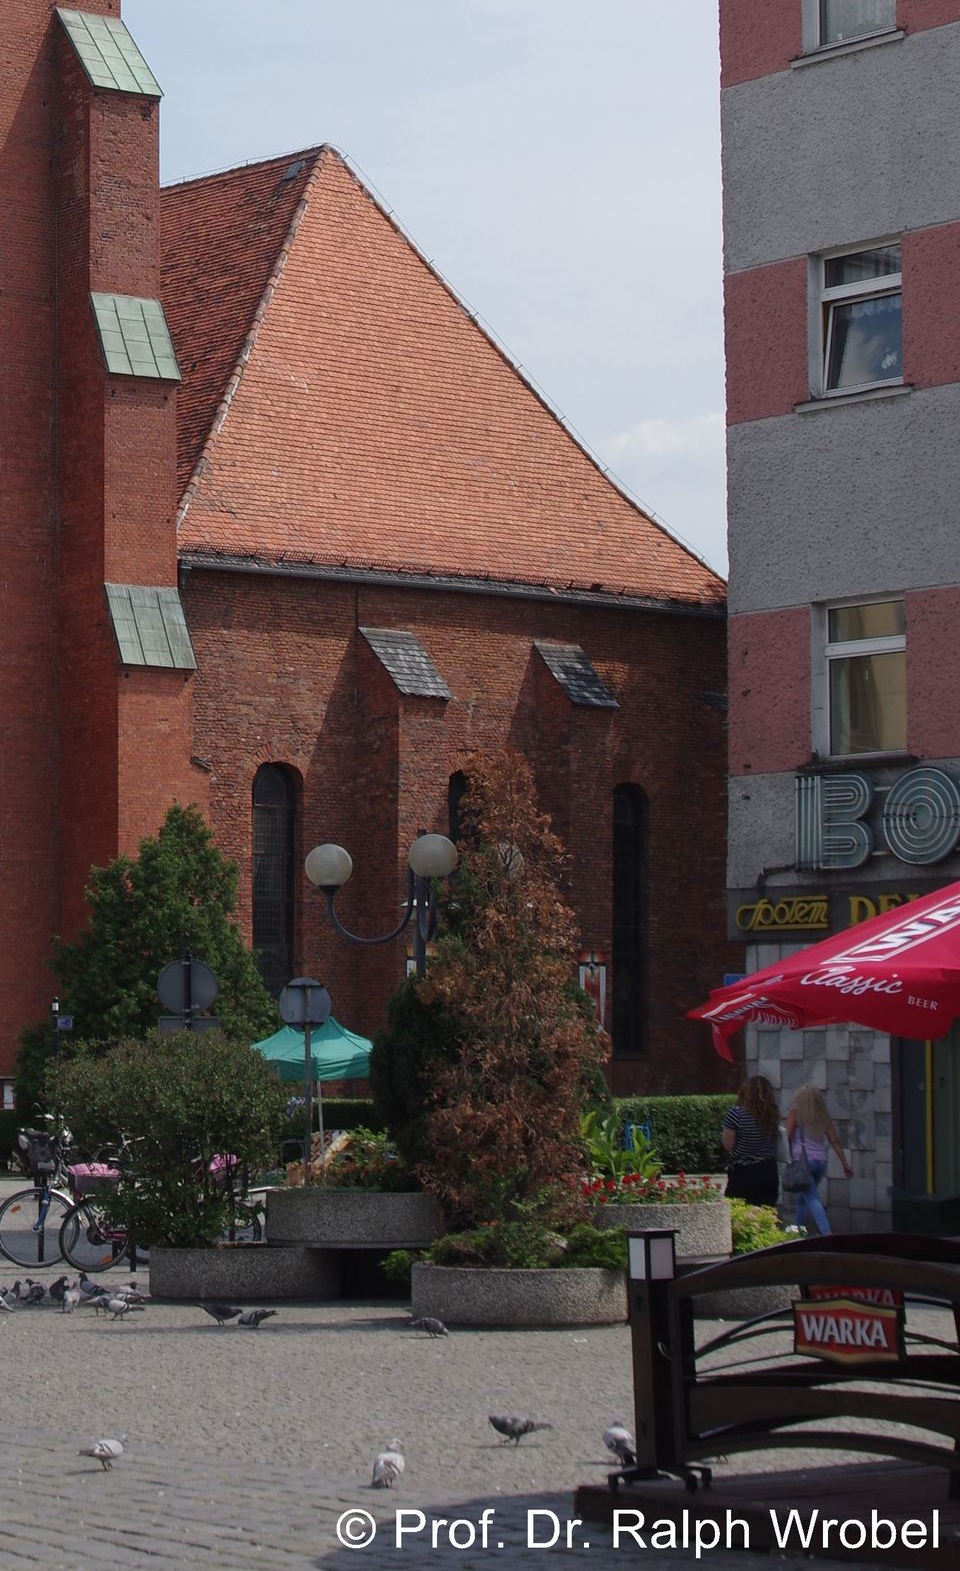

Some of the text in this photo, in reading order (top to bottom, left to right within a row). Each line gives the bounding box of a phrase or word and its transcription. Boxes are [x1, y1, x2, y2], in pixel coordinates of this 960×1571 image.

[801, 965, 903, 995] Classic
[907, 995, 939, 1010] BEER
[800, 1314, 889, 1348] WARKA
